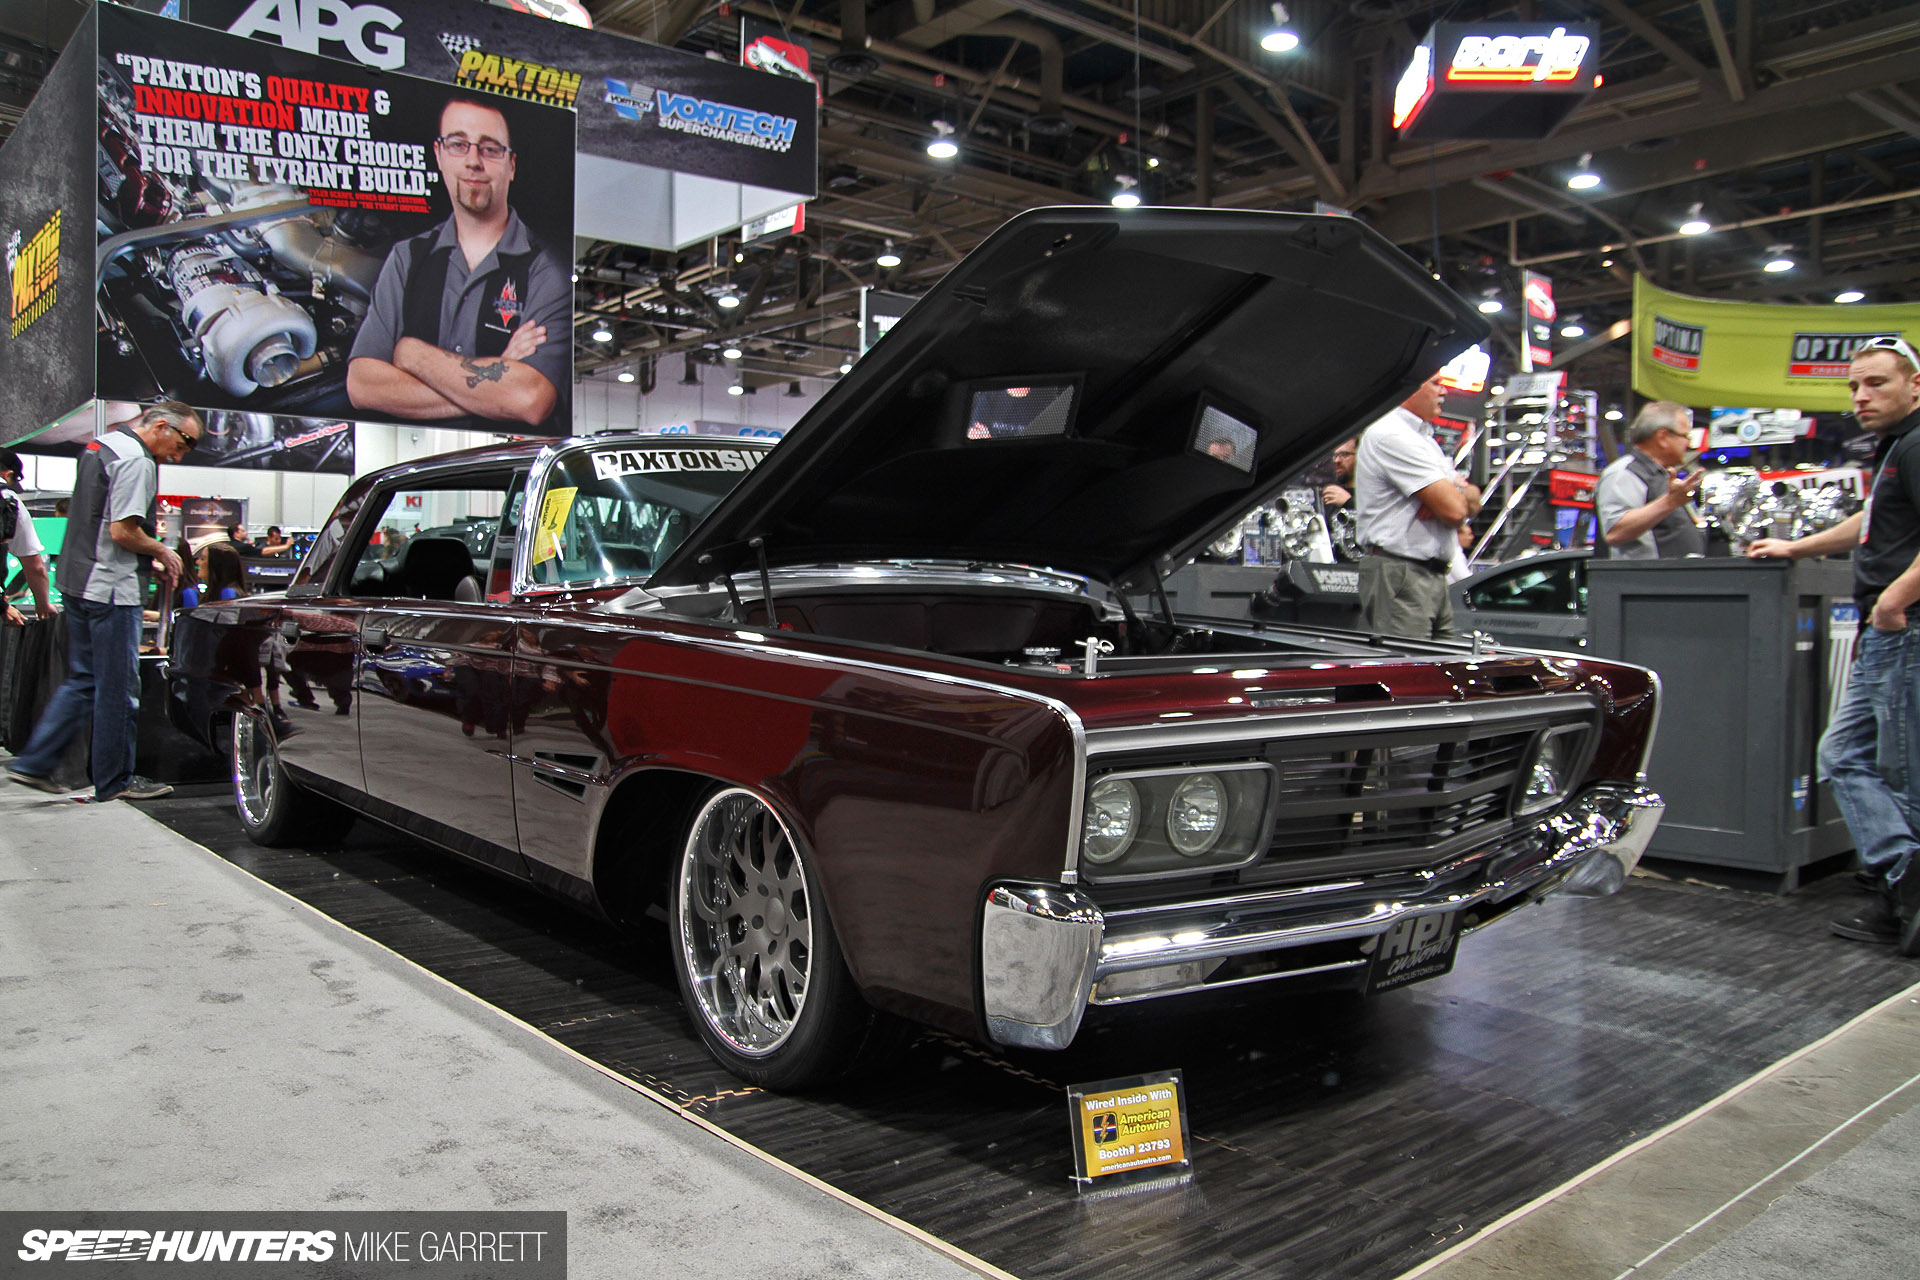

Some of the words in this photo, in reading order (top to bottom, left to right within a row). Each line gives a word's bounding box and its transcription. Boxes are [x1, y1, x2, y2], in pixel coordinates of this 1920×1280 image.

[227, 0, 405, 70] APG
[266, 75, 369, 114] QUALITY
[374, 89, 391, 115] &
[457, 50, 581, 101] PAXTON
[133, 85, 295, 131] INNOVATION
[300, 106, 371, 140] MADE
[610, 94, 652, 111] VORTECH
[656, 89, 797, 142] VORTECH
[135, 114, 217, 151] THEM
[221, 124, 273, 157] THE
[278, 131, 340, 164] ONLY
[344, 139, 426, 171] CHOICE
[659, 117, 766, 148] SUPERCHARGERS
[140, 143, 193, 177] FOR
[196, 151, 250, 182] THE
[254, 155, 354, 190] TYRANT
[11, 209, 61, 319] PAXTON
[1656, 321, 1699, 353] OPTIMA
[1380, 910, 1456, 960] HPI
[1086, 1098, 1115, 1111] Wired
[1118, 1093, 1148, 1106] Inside
[1150, 1089, 1172, 1100] With
[1119, 1109, 1170, 1125] American
[1121, 1119, 1170, 1136] Autowire
[1099, 1145, 1135, 1160] Booth#
[1138, 1139, 1171, 1153] 23793
[1101, 1154, 1172, 1172] americanautowire.com
